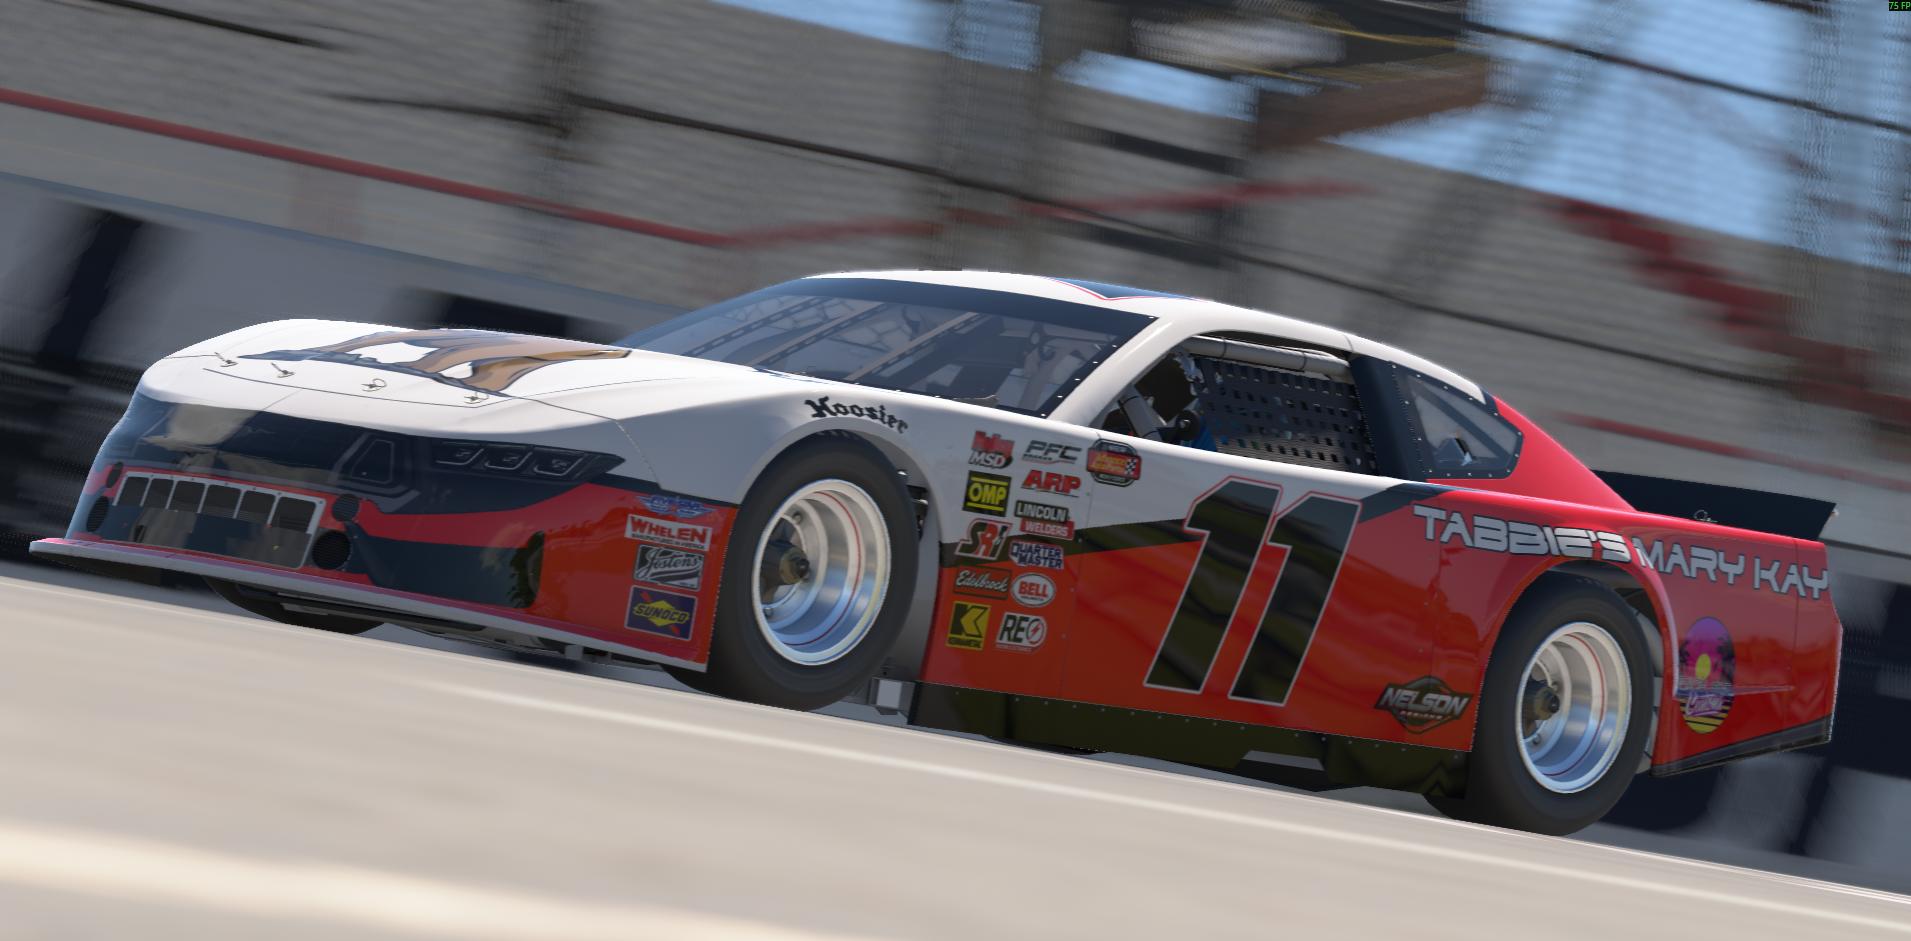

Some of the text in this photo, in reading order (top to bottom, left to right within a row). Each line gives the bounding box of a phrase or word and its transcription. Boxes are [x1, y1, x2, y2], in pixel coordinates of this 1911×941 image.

[804, 396, 908, 434] Hoosier
[969, 450, 1010, 469] MSD
[1025, 439, 1082, 461] PFC
[1022, 469, 1082, 494] ARP
[968, 482, 1007, 506] OMP
[1017, 503, 1067, 521] LINCOLN
[631, 517, 708, 543] WHELEN
[1024, 521, 1069, 537] WELDERS
[1011, 542, 1061, 561] QUARTER
[1018, 555, 1064, 569] MASTER
[1413, 504, 1830, 600] TABBIE'S MARY KAY
[1018, 581, 1049, 598] BELL
[1143, 477, 1362, 706] 11
[635, 604, 688, 622] SUNOCO
[1378, 686, 1471, 718] NELSON
